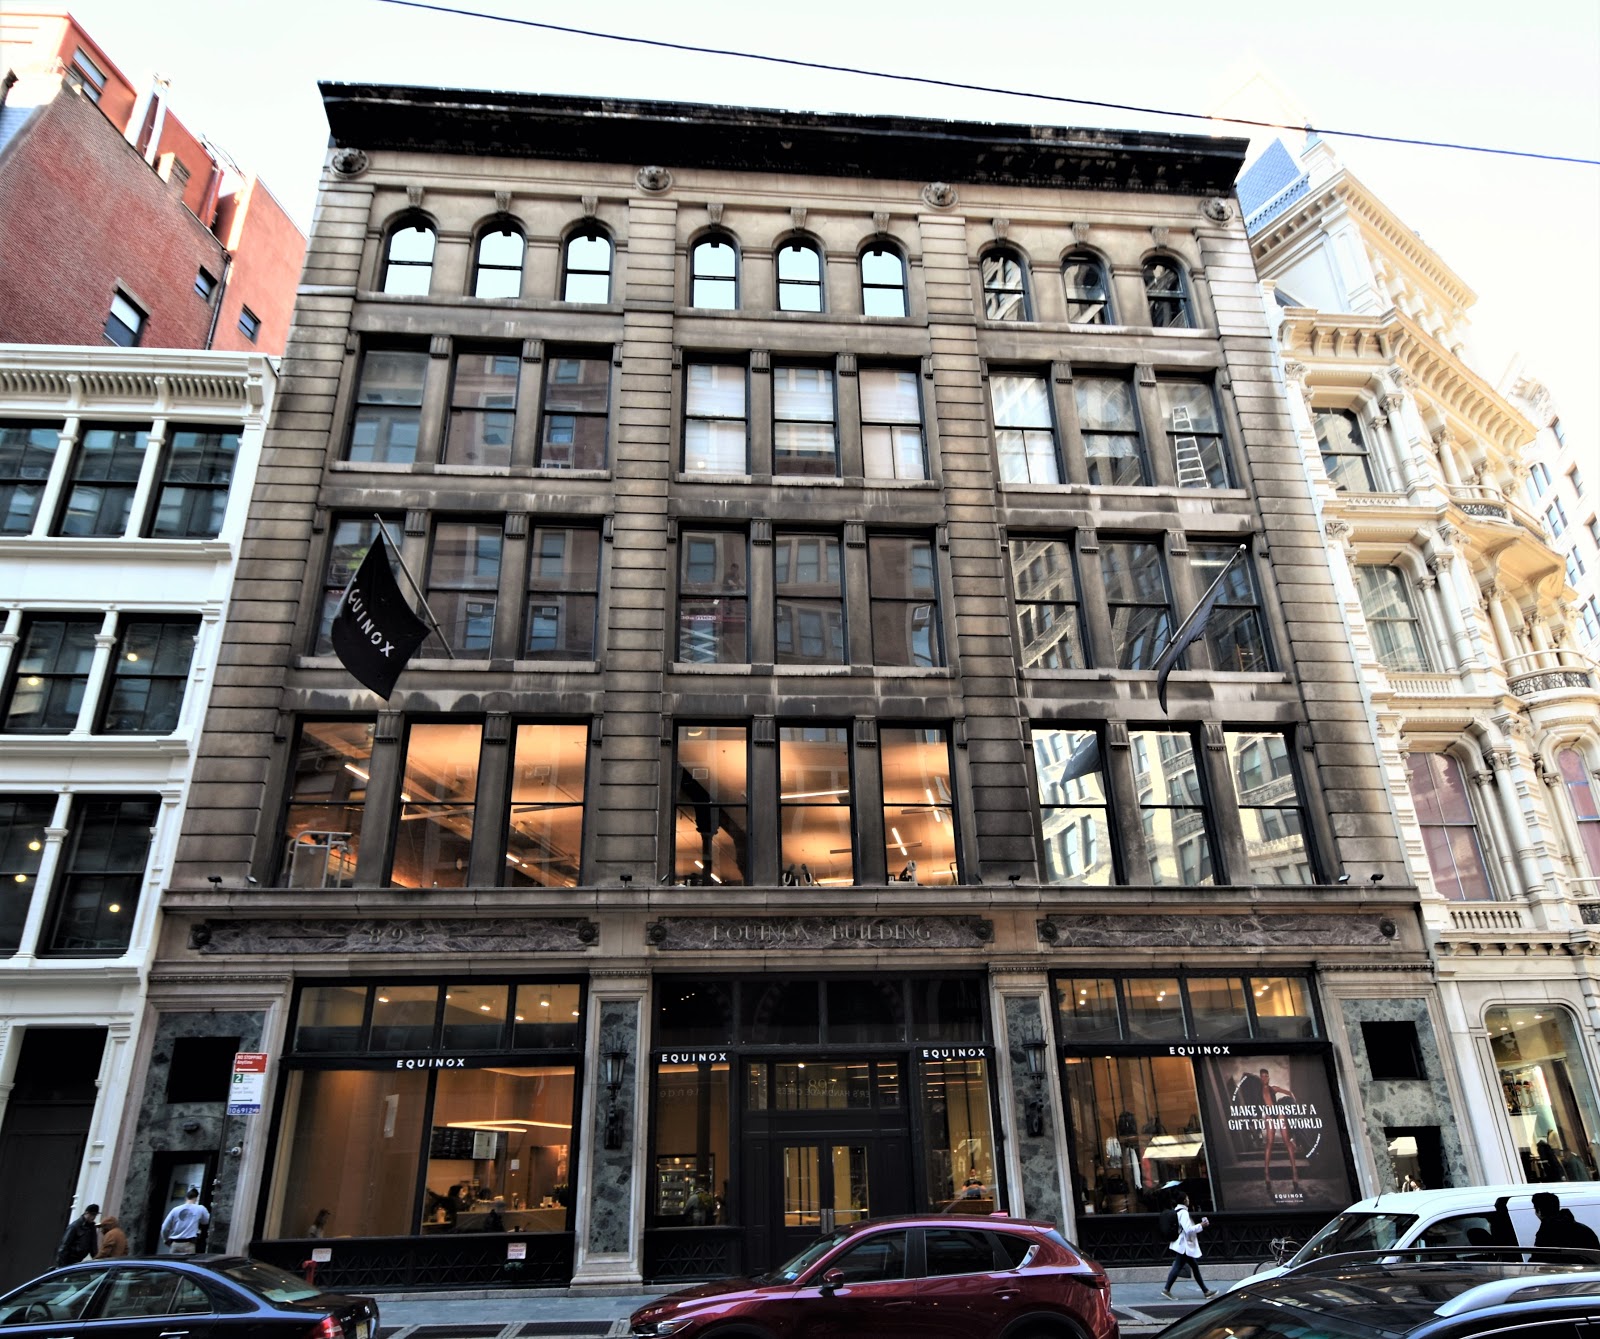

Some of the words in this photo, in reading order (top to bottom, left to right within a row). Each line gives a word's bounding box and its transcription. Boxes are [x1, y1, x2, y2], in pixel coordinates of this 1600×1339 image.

[347, 578, 395, 657] QUINOX
[368, 927, 426, 944] 895
[713, 925, 812, 941] EQUINOX
[832, 924, 931, 940] BUILDING
[922, 1048, 986, 1059] EQUINOX
[1169, 1046, 1231, 1056] EQUINOX
[396, 1058, 466, 1069] EQUINOX
[661, 1052, 727, 1063] EQUINOX
[235, 1074, 242, 1083] 2
[1230, 1105, 1258, 1117] MAKE
[1259, 1104, 1307, 1116] YOURSELF
[1309, 1104, 1317, 1115] A
[1228, 1119, 1250, 1131] GIFT
[1252, 1119, 1266, 1131] TO
[1266, 1118, 1286, 1130] THE
[1287, 1118, 1323, 1130] WORLD
